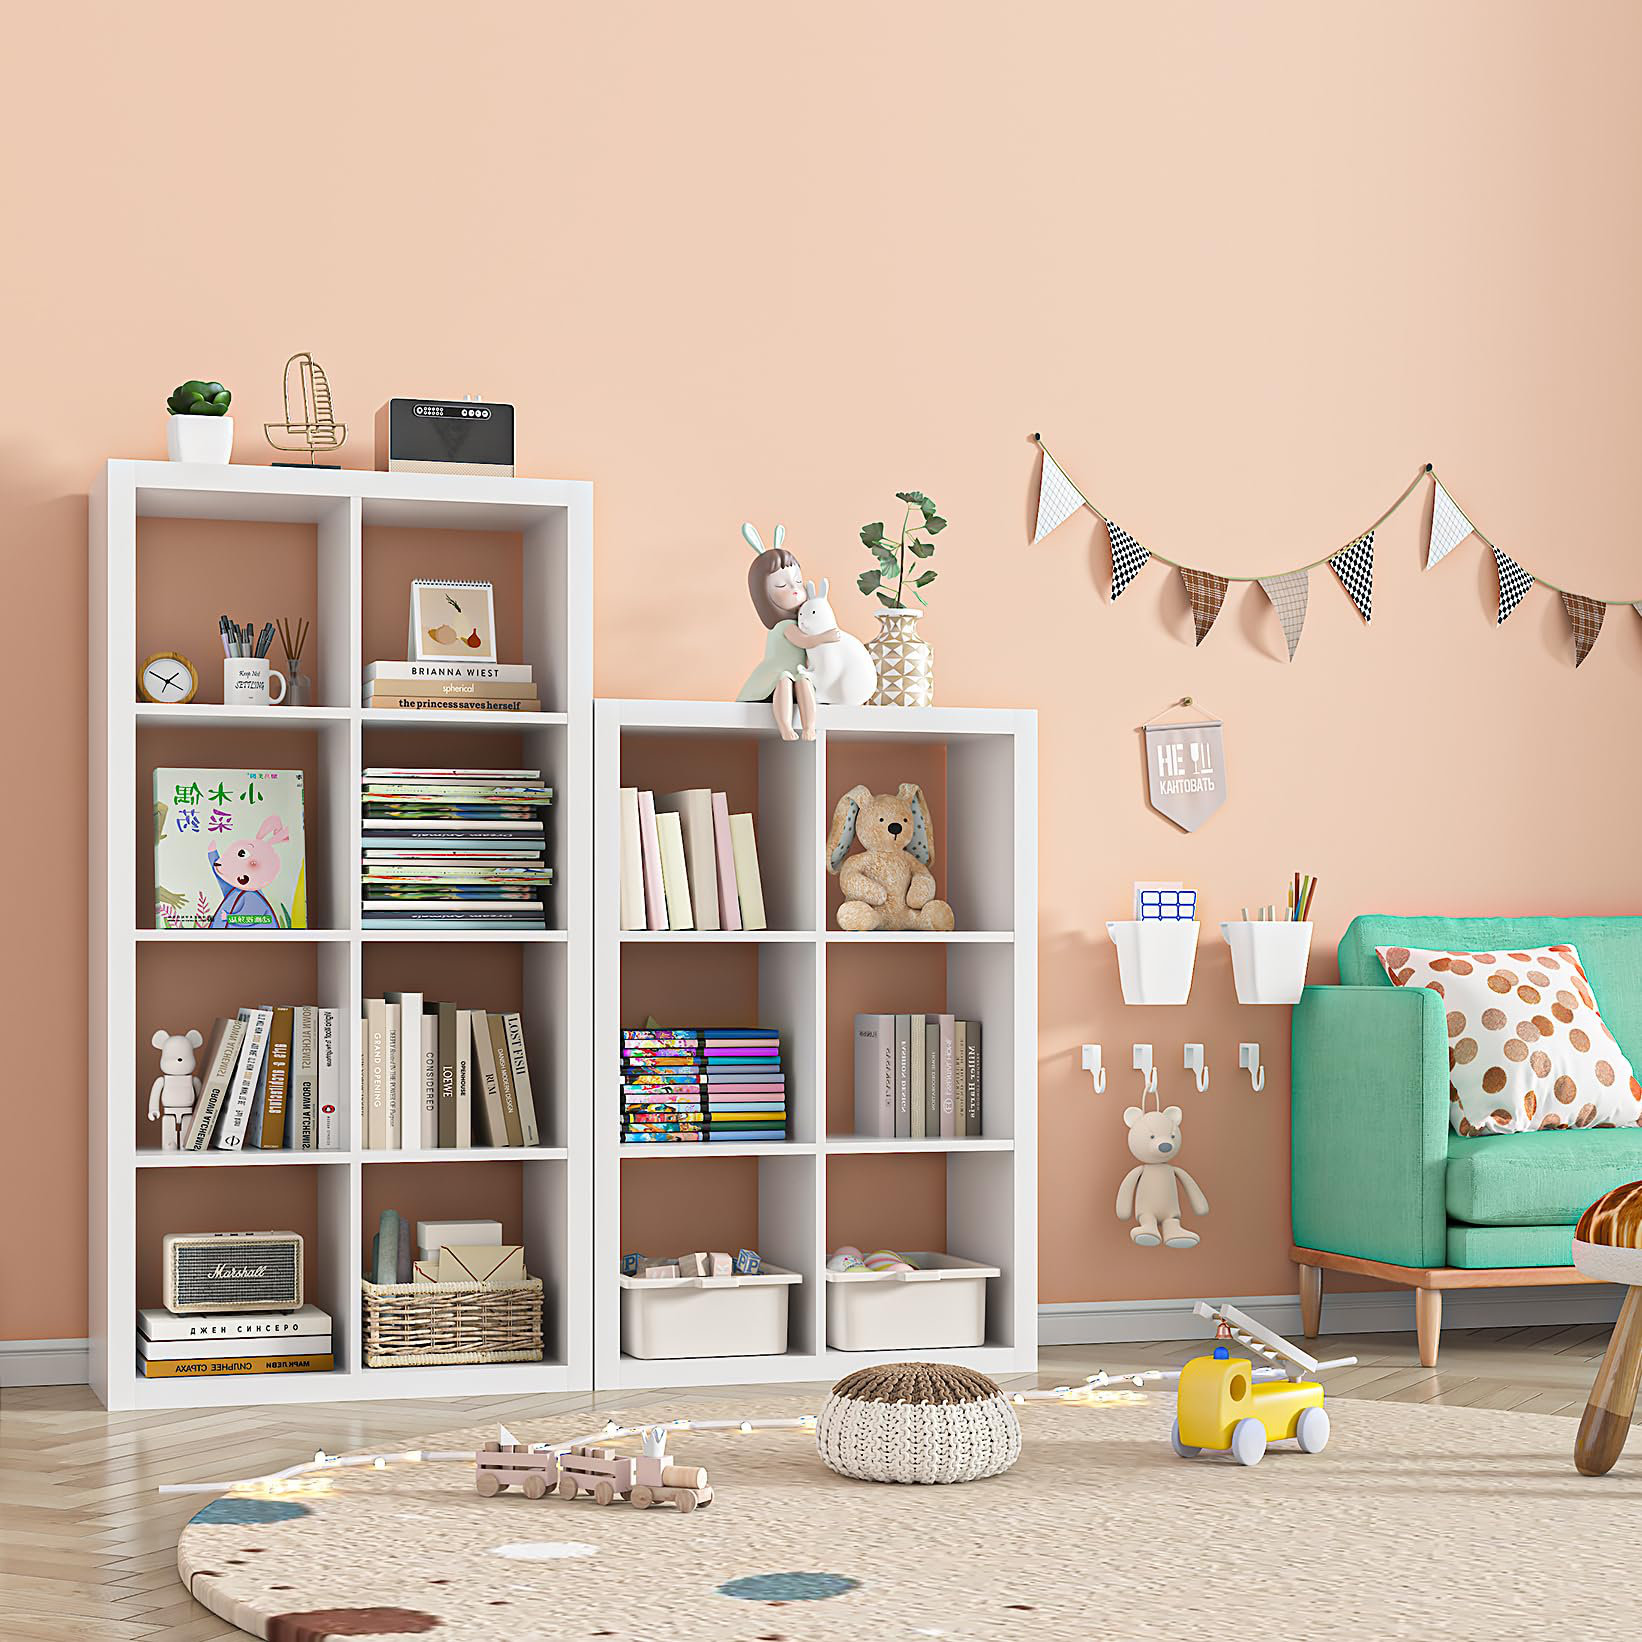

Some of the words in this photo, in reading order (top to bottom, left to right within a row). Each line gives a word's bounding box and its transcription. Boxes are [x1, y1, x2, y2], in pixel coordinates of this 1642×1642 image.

[411, 667, 462, 676] BRIANNA
[467, 668, 499, 677] WIEST
[442, 683, 474, 693] spherical
[399, 700, 416, 708] the
[416, 700, 458, 709] princess
[486, 701, 521, 710] herself
[1157, 743, 1185, 777] НЕ
[1160, 777, 1215, 795] КАНТОВАТЬ
[508, 1018, 521, 1047] LOST
[497, 1048, 506, 1069] DANISH
[513, 1049, 526, 1075] FISH
[426, 1052, 434, 1111] CONSIDERED
[443, 1066, 453, 1097] LOEWE
[486, 1073, 497, 1095] RUM
[500, 1069, 510, 1093] MODERN
[505, 1093, 514, 1113] DESIGN
[207, 1263, 267, 1279] Marshall
[625, 1256, 635, 1271] P
[747, 1259, 758, 1273] P
[190, 1326, 226, 1336] ДЖЕН
[237, 1323, 299, 1333] СИНСЕРО
